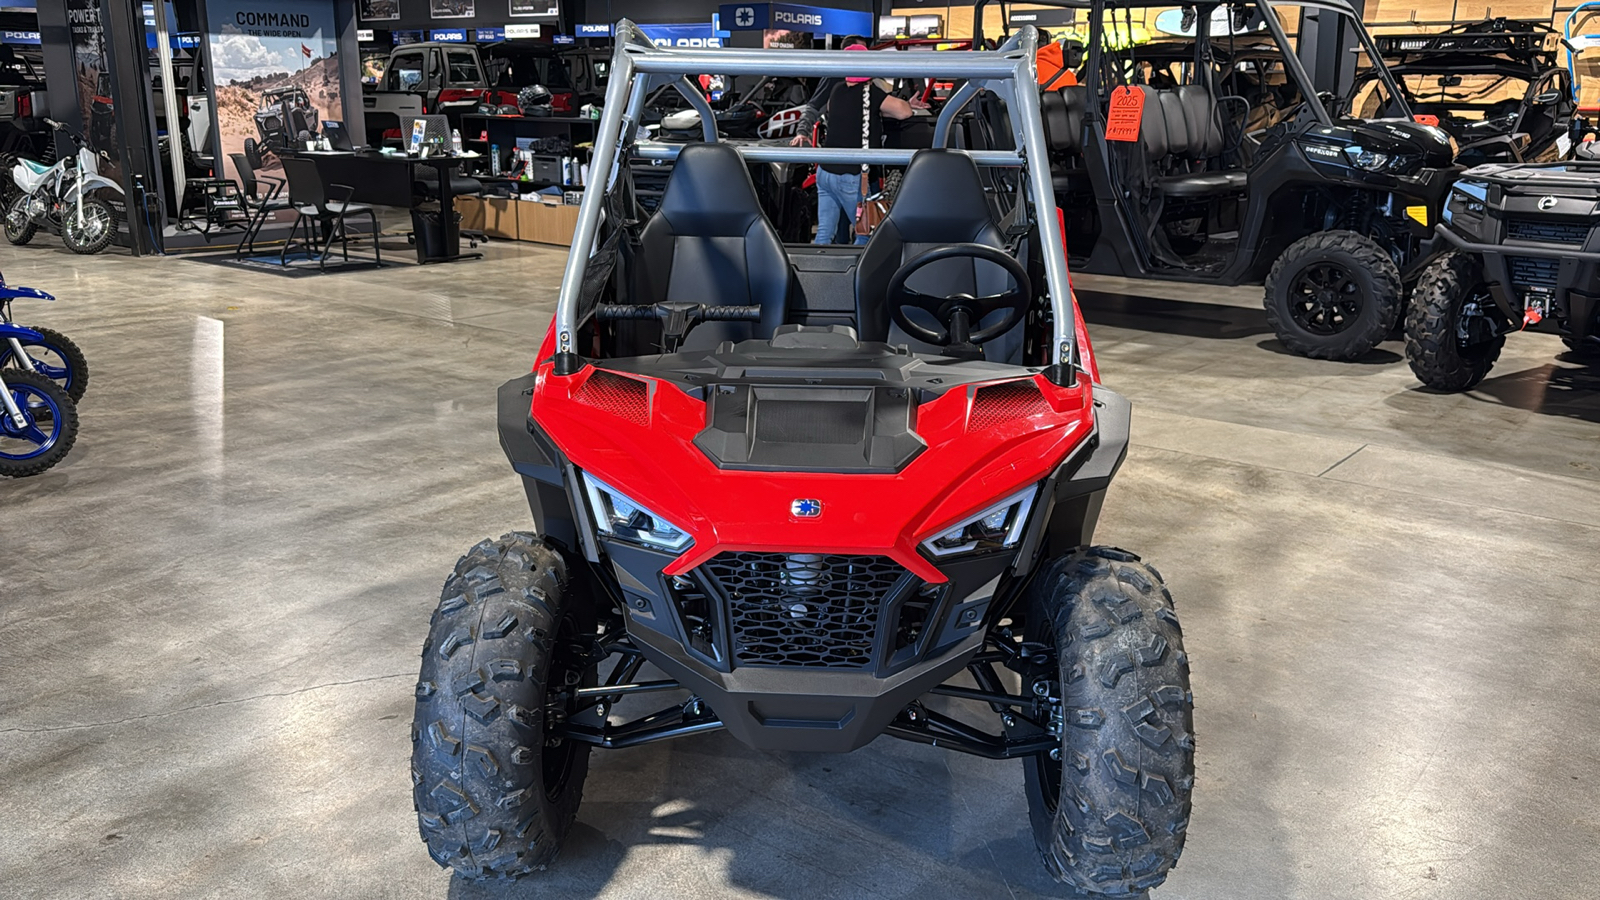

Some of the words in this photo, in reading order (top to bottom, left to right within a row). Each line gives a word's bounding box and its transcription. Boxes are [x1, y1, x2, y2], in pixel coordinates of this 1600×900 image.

[68, 9, 95, 23] POWER
[236, 12, 310, 28] COMMAND
[775, 12, 822, 26] POLARIS
[651, 38, 721, 48] OLARIS
[1117, 96, 1138, 106] 2025
[1306, 146, 1338, 158] DEFENDER
